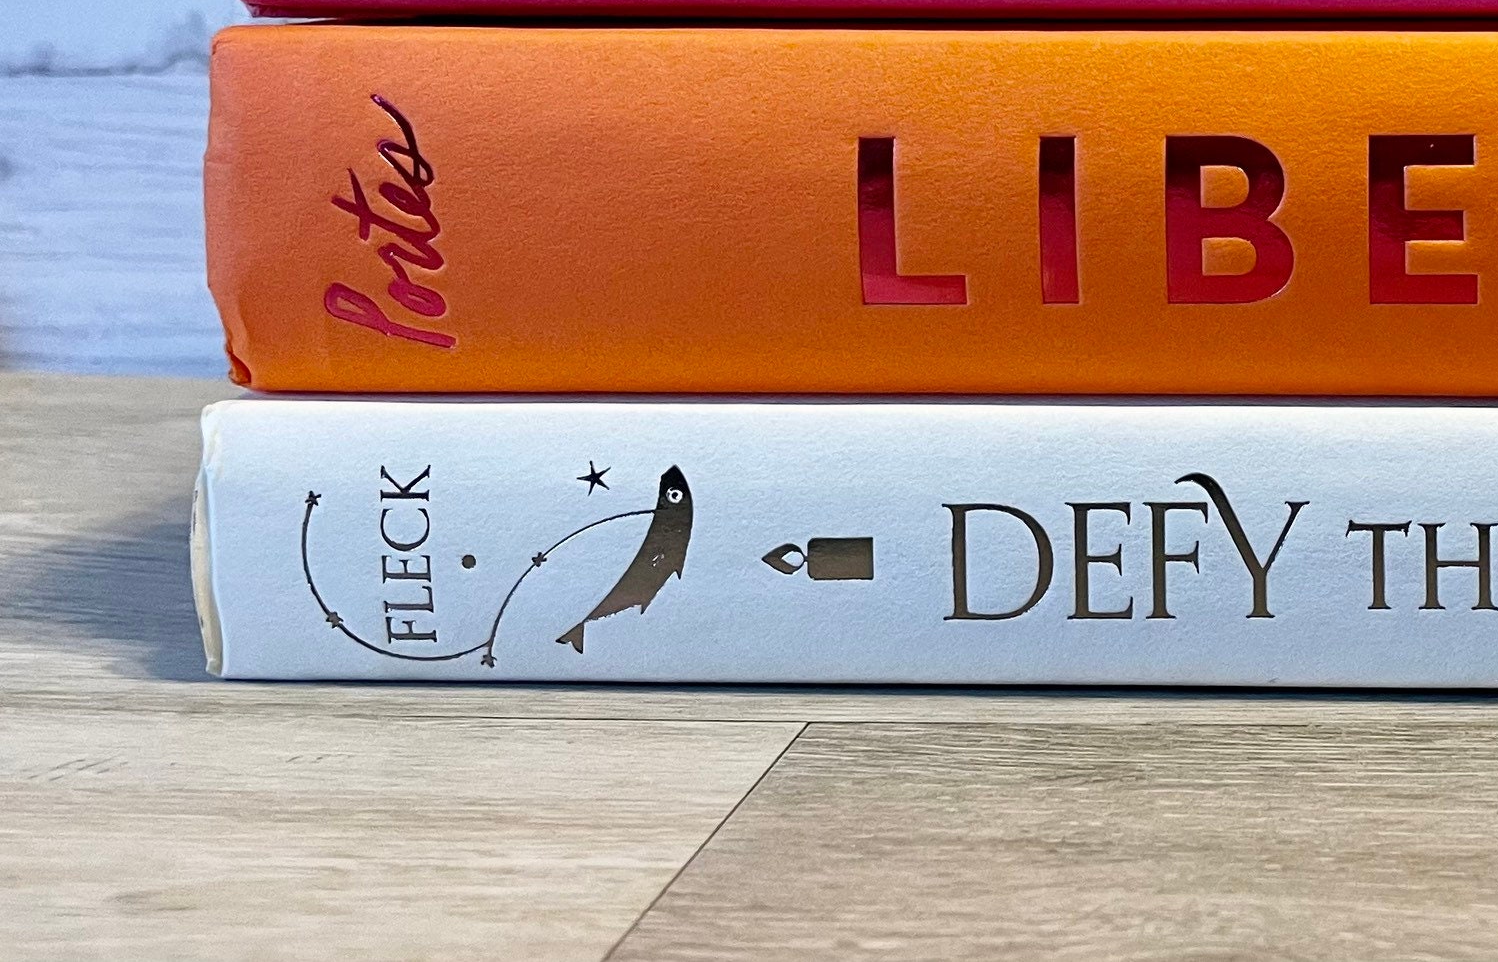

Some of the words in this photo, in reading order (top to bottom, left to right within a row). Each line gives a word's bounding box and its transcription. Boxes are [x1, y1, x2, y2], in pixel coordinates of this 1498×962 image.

[324, 93, 457, 349] Portes
[380, 464, 437, 644] FLECK
[941, 472, 1311, 621] DEFY
